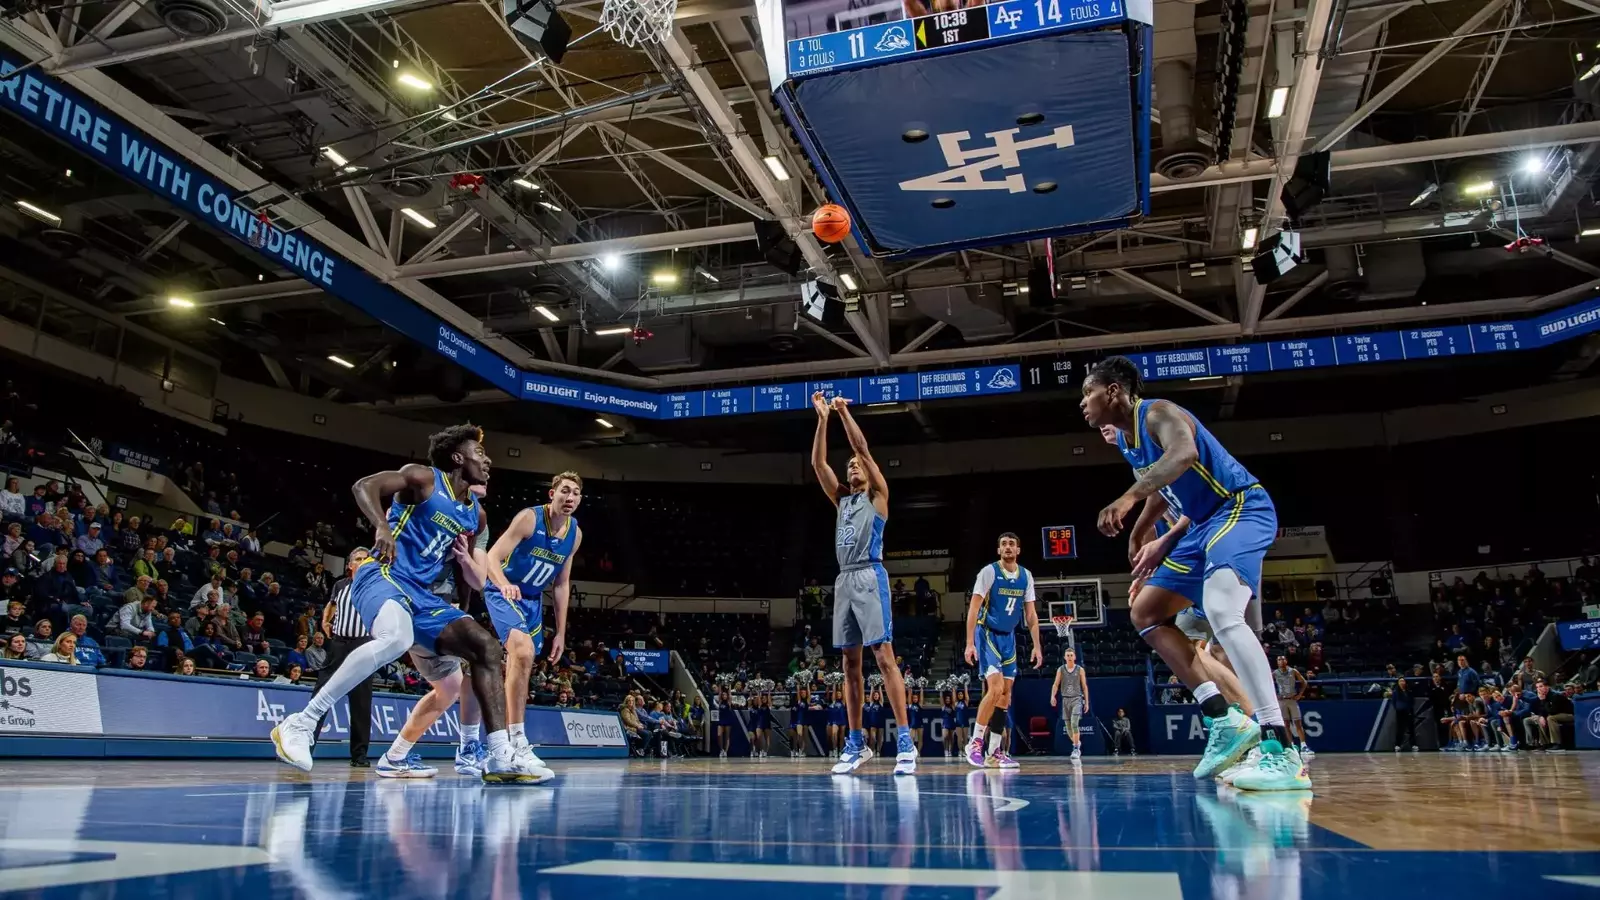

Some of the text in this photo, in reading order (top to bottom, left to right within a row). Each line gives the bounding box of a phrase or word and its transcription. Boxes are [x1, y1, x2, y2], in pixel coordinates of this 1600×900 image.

[1034, 0, 1063, 26] 14
[1070, 1, 1118, 21] FOULS 4
[933, 10, 967, 31] 10:38
[942, 28, 960, 44] 1ST
[798, 38, 824, 53] 4 TOL
[848, 31, 865, 59] 11
[799, 51, 835, 67] 3 FOULS
[0, 60, 335, 286] RETIRE WITH CONFIDENCE
[1540, 309, 1600, 336] BUD LIGHT
[440, 326, 476, 356] Old Dominion
[1411, 331, 1419, 339] 22
[1426, 337, 1454, 346] PTS 2
[1494, 332, 1506, 341] PTS
[438, 340, 458, 358] Drexel
[1292, 350, 1303, 358] PTS
[1357, 344, 1368, 352] PTS
[1450, 346, 1456, 354] 0
[1155, 354, 1167, 364] OFF
[1168, 351, 1204, 363] REBOUNDS
[1231, 355, 1242, 363] PTS
[504, 365, 516, 379] 5:00
[1052, 361, 1072, 371] 10:38
[1157, 366, 1169, 376] DEF
[1170, 363, 1206, 375] REBOUNDS
[921, 370, 980, 384] OFF REBOUNDS 5
[1029, 367, 1041, 385] 11
[1057, 375, 1069, 384] 1ST
[526, 382, 579, 398] BUD LIGHT
[922, 382, 981, 396] DEF REBOUNDS 9
[584, 392, 658, 412] Enjoy Responsibly
[836, 525, 855, 547] 22
[1049, 529, 1071, 539] 10:38
[1051, 539, 1070, 555] 30
[521, 560, 555, 587] 10
[1005, 597, 1017, 615] 4
[8, 715, 36, 728] Group
[586, 722, 621, 739] centura
